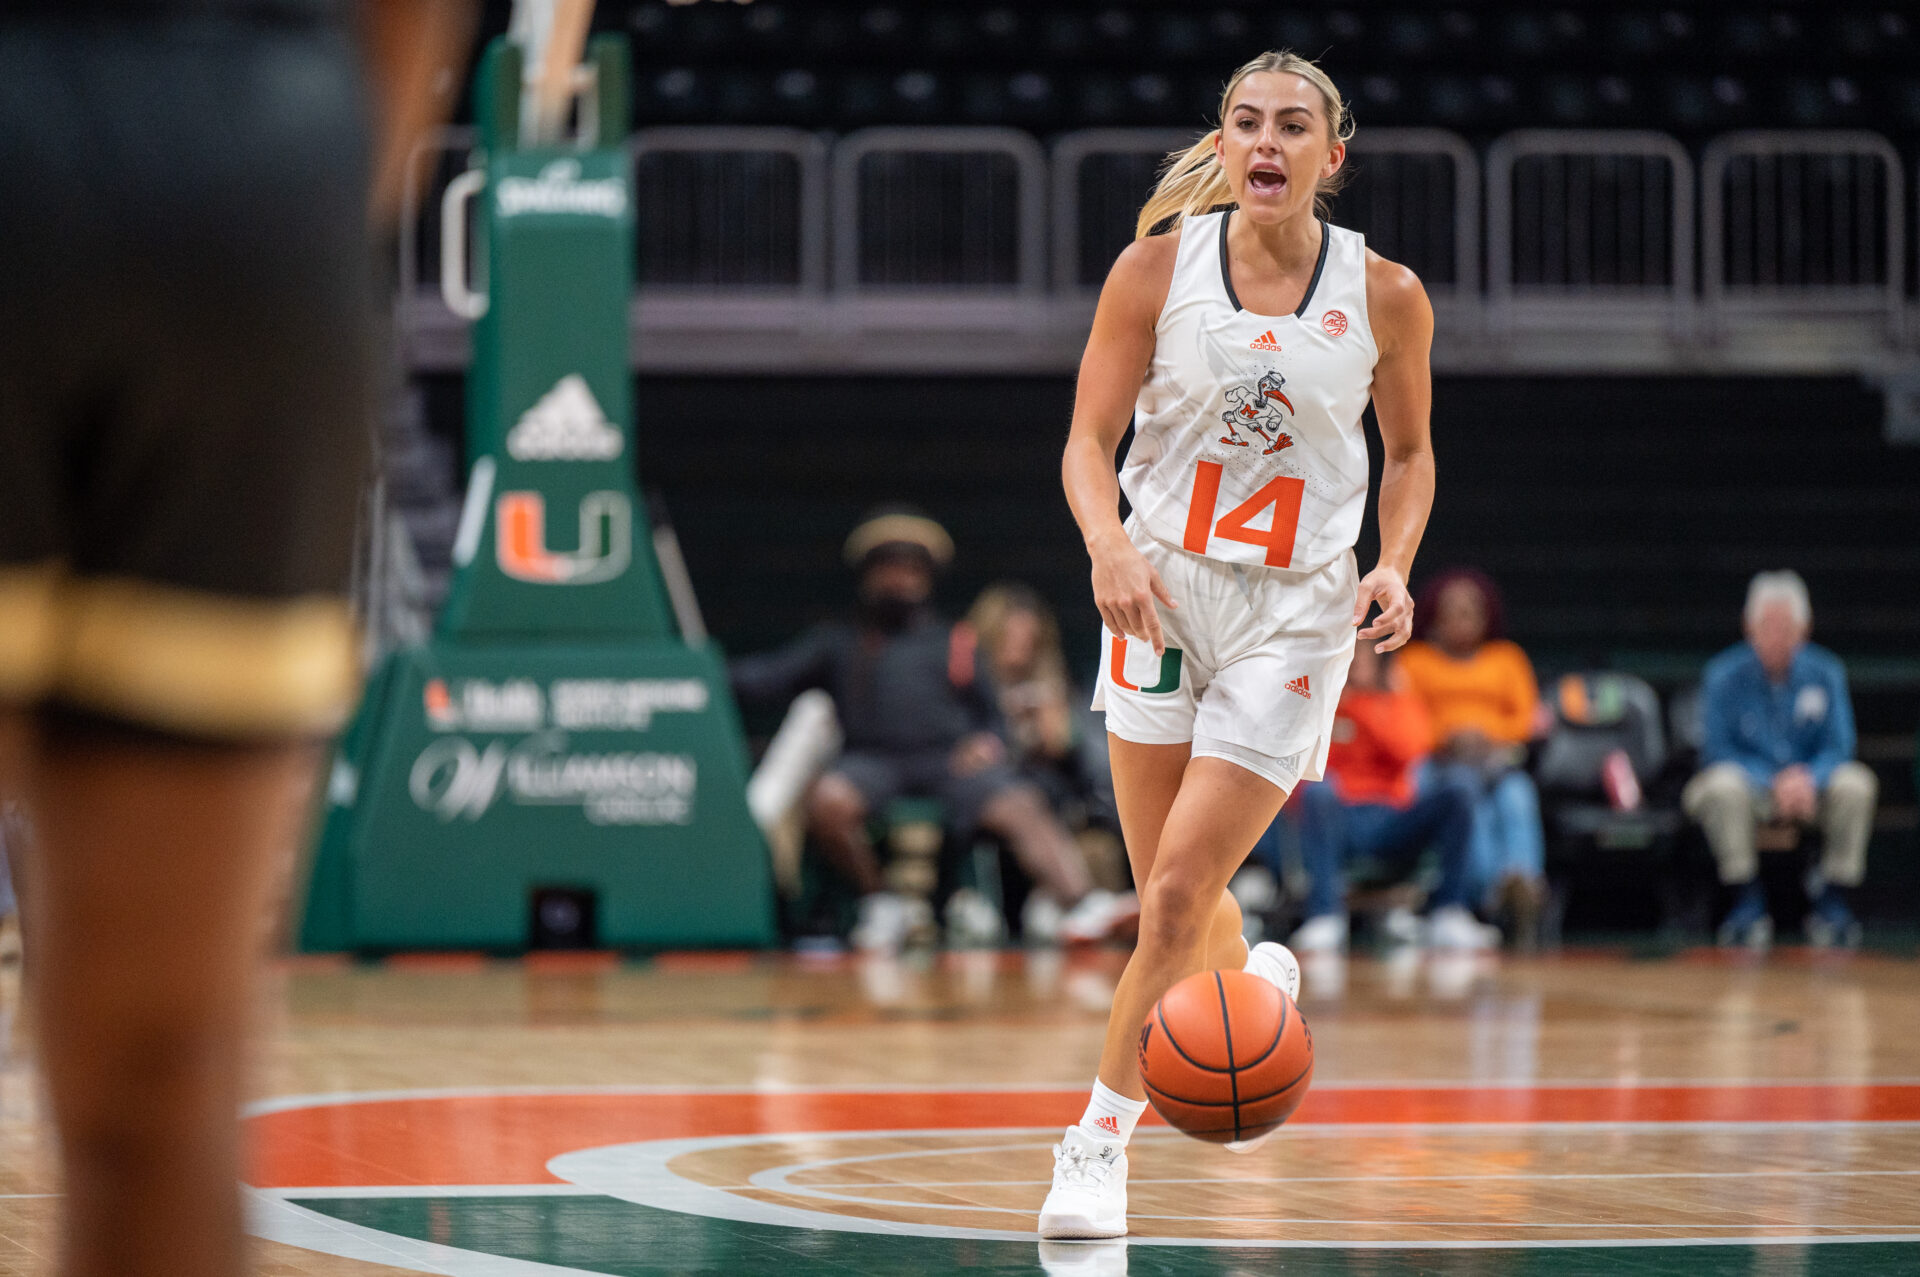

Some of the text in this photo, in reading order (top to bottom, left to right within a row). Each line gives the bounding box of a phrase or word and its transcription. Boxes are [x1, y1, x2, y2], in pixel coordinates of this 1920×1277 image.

[1249, 342, 1282, 352] adidas
[1183, 459, 1306, 568] 14
[496, 490, 632, 585] U
[1110, 636, 1183, 694] U
[1284, 683, 1312, 700] adidas
[1094, 1119, 1120, 1135] adidas
